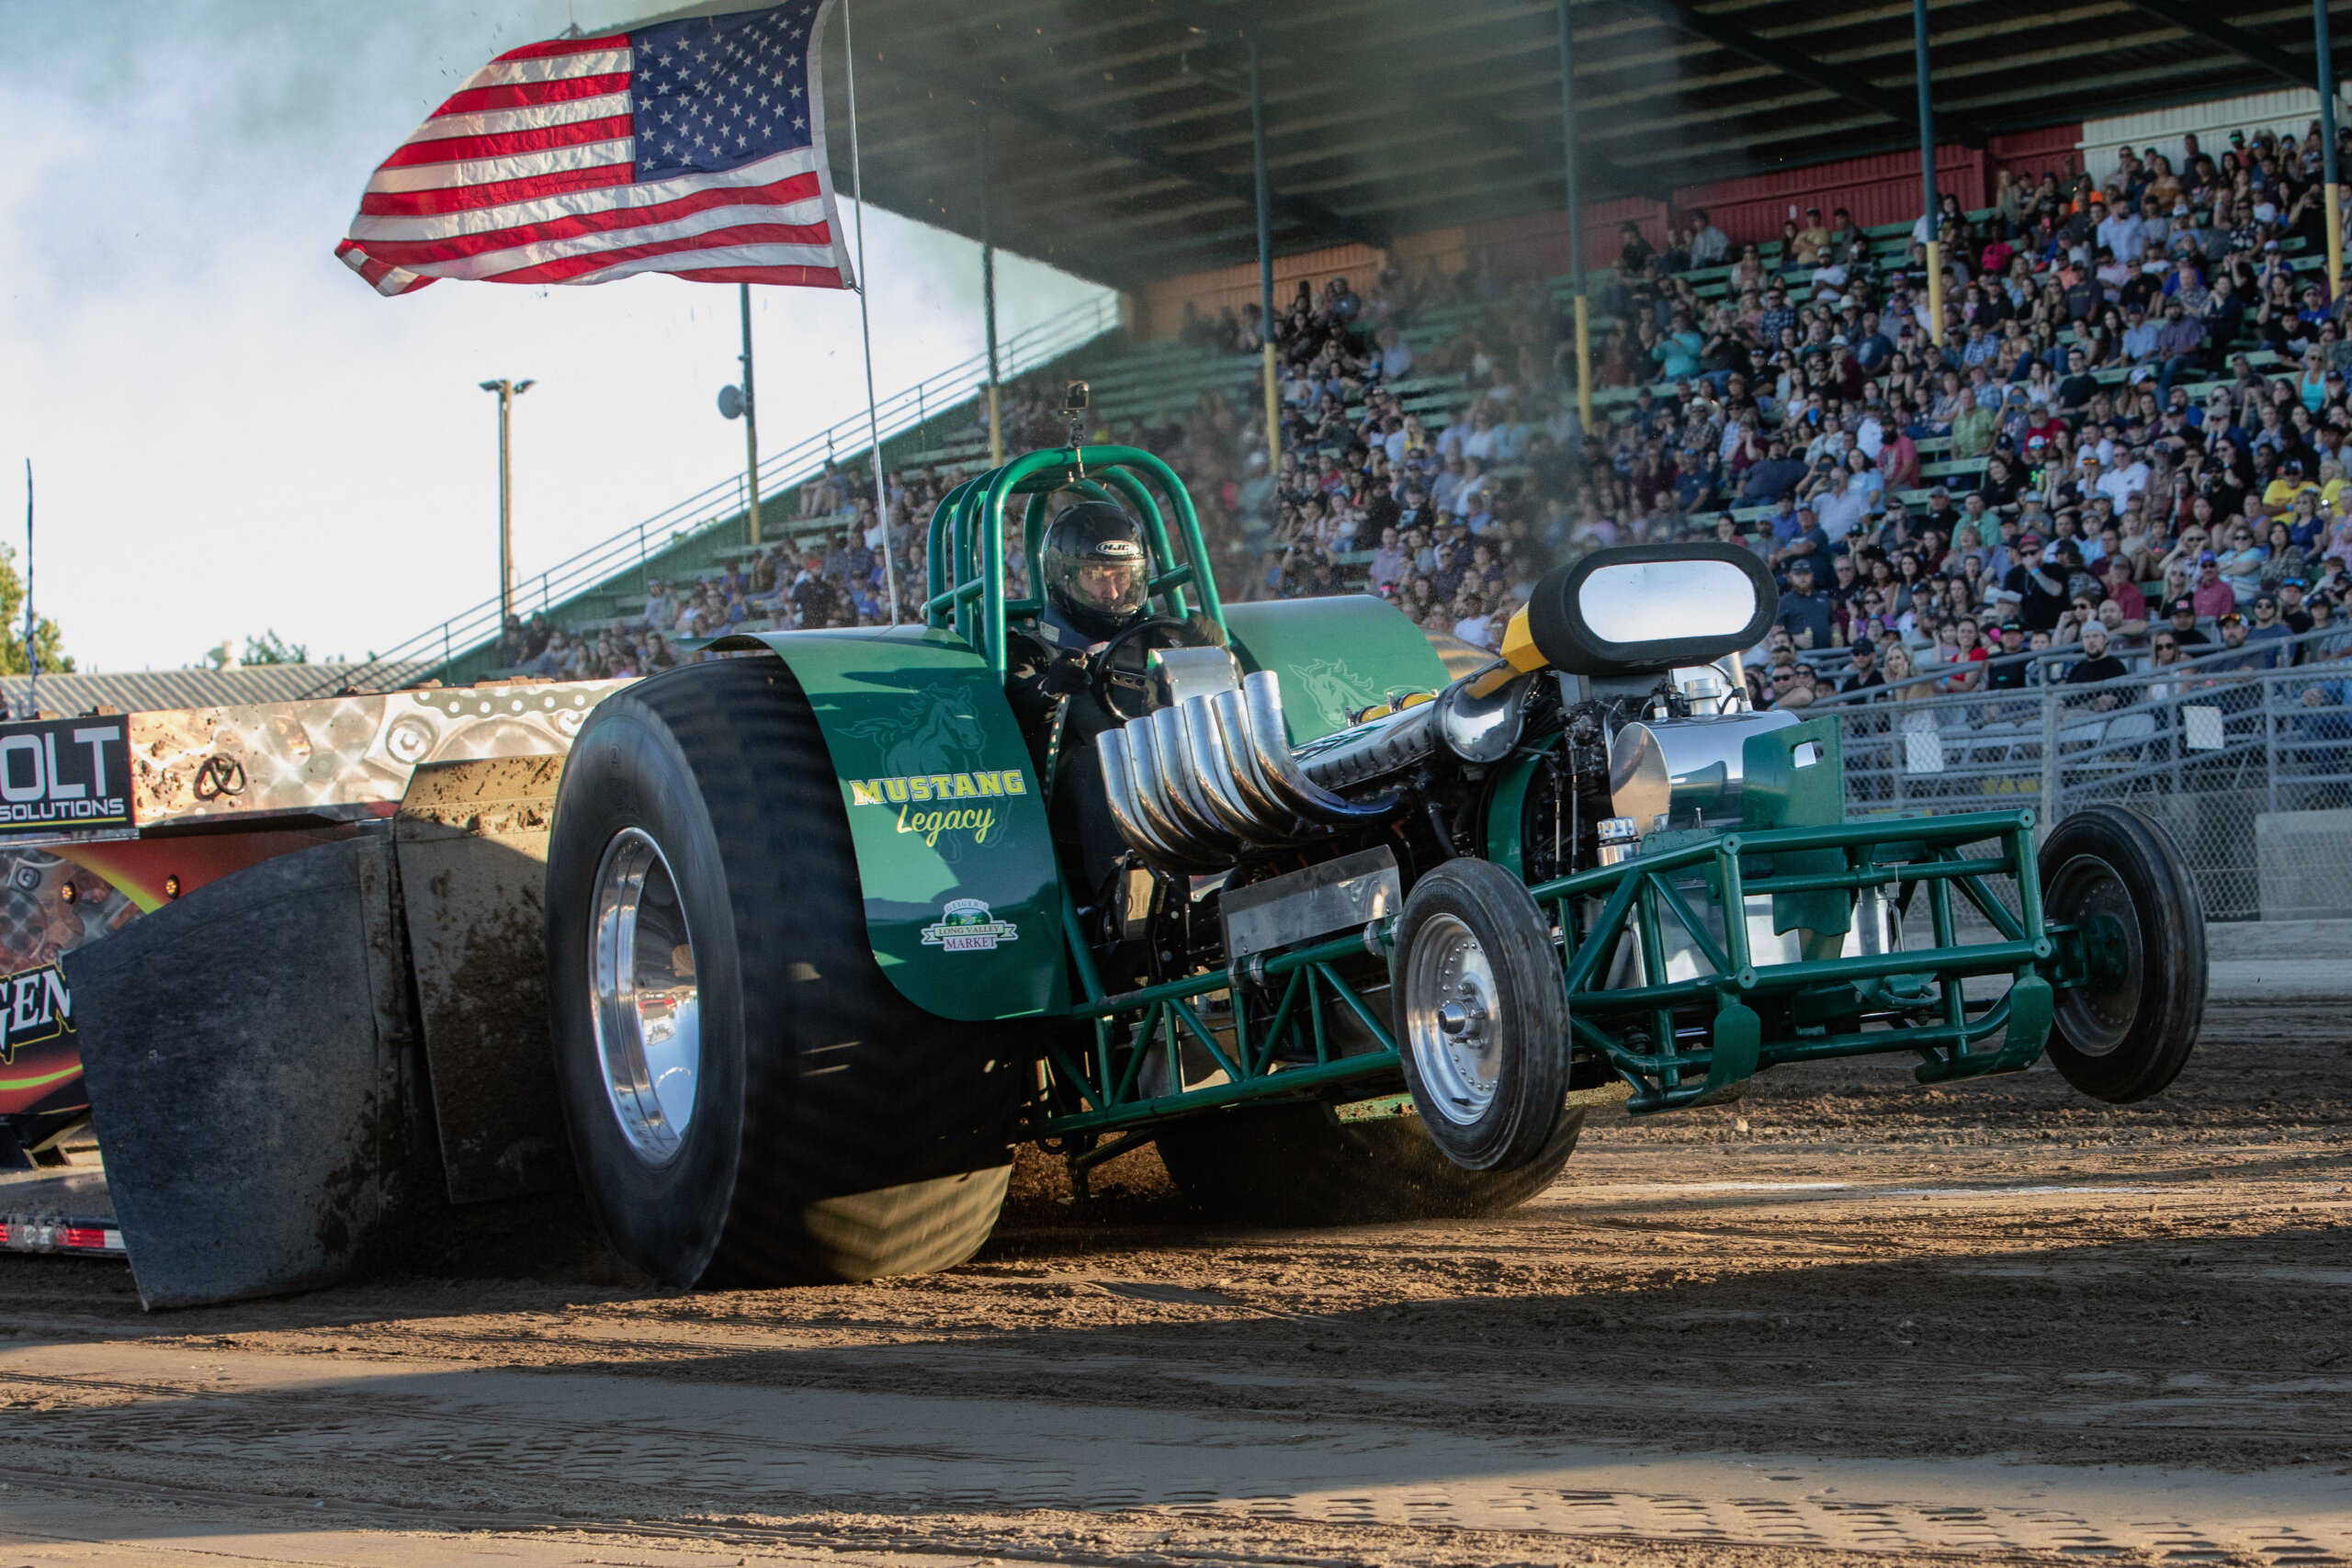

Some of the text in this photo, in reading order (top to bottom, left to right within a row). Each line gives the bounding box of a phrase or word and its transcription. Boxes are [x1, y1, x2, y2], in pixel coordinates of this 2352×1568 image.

[849, 770, 1027, 806] MUSTANG
[0, 798, 125, 822] SOLUTIONS
[897, 804, 995, 847] Legacy
[945, 900, 989, 911] GEIGER'S
[939, 925, 1000, 935] LONG VALLEY
[945, 936, 996, 950] MARKET
